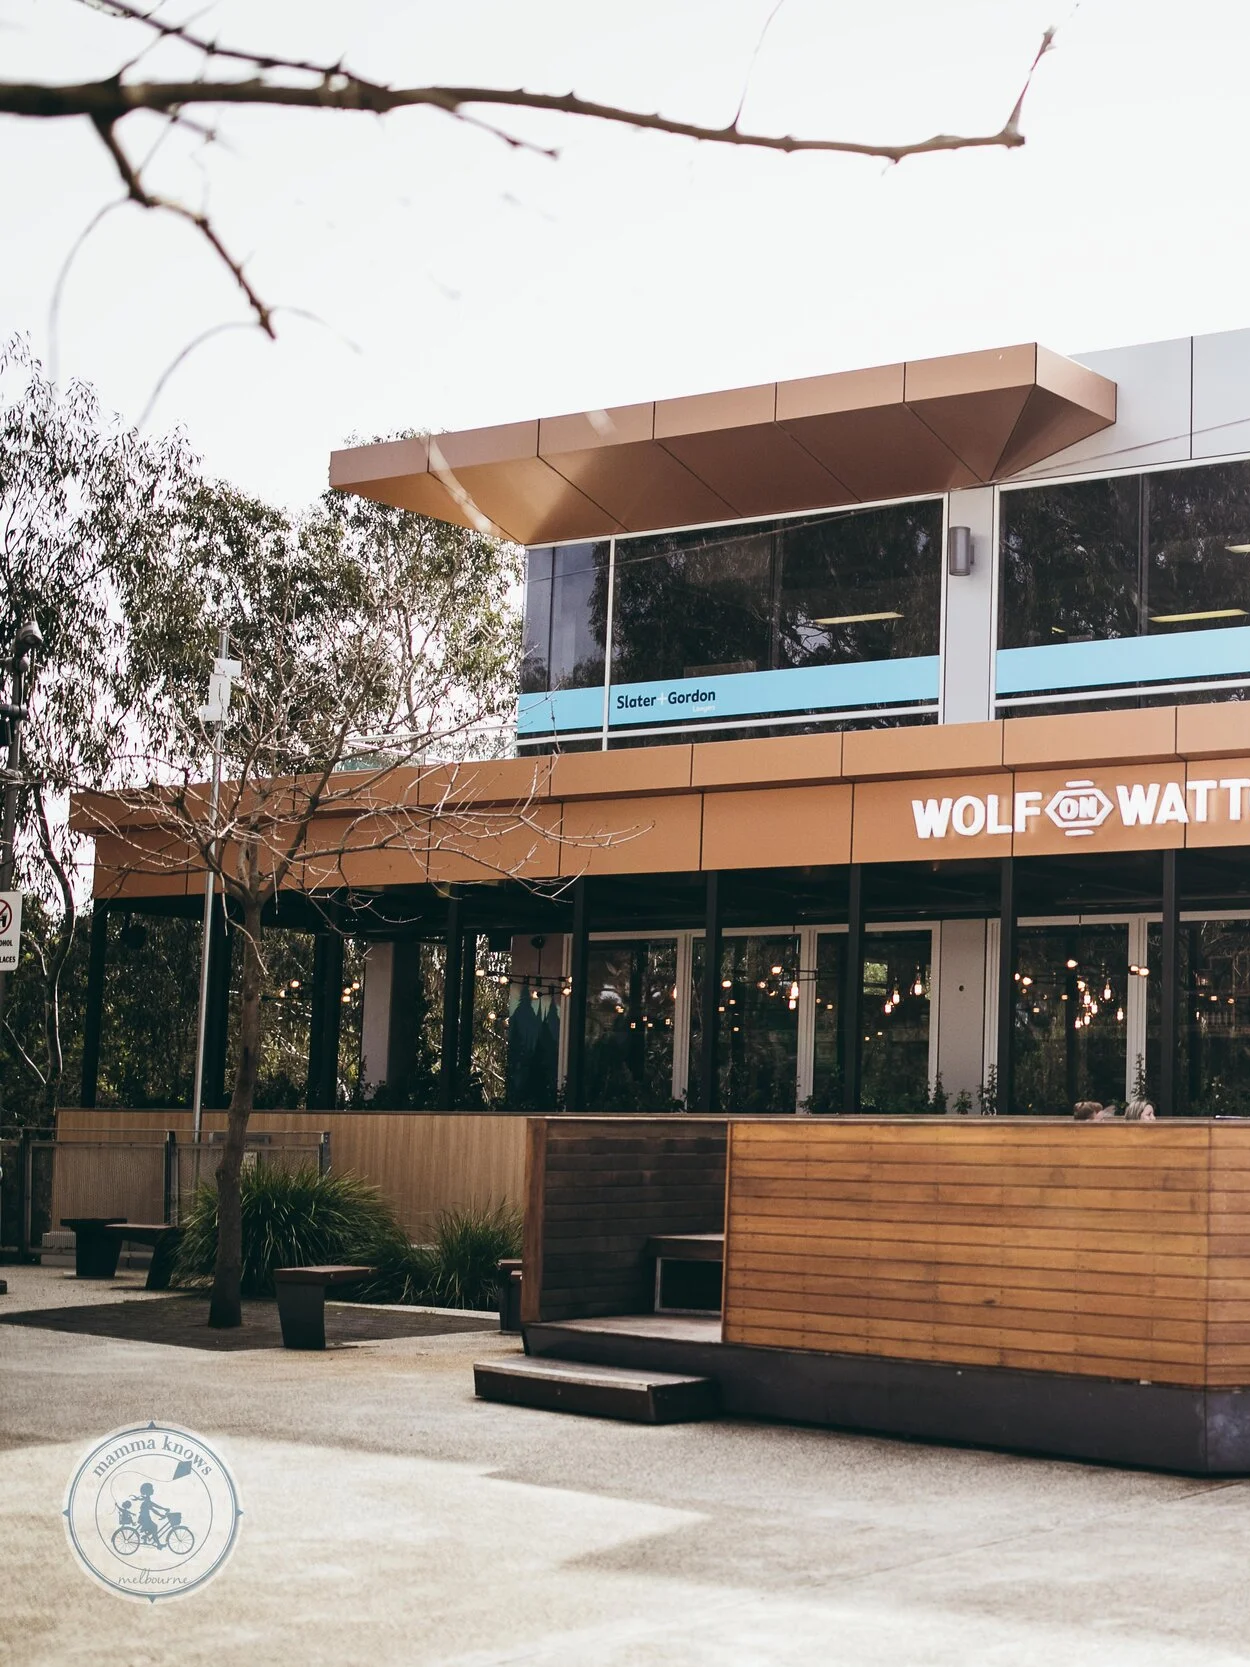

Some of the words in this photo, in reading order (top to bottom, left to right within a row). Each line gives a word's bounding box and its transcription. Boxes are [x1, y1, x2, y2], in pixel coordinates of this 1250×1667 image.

[617, 695, 656, 709] Slater
[668, 689, 716, 704] Gordon
[912, 791, 1043, 839] WOLF
[1059, 796, 1098, 820] ON
